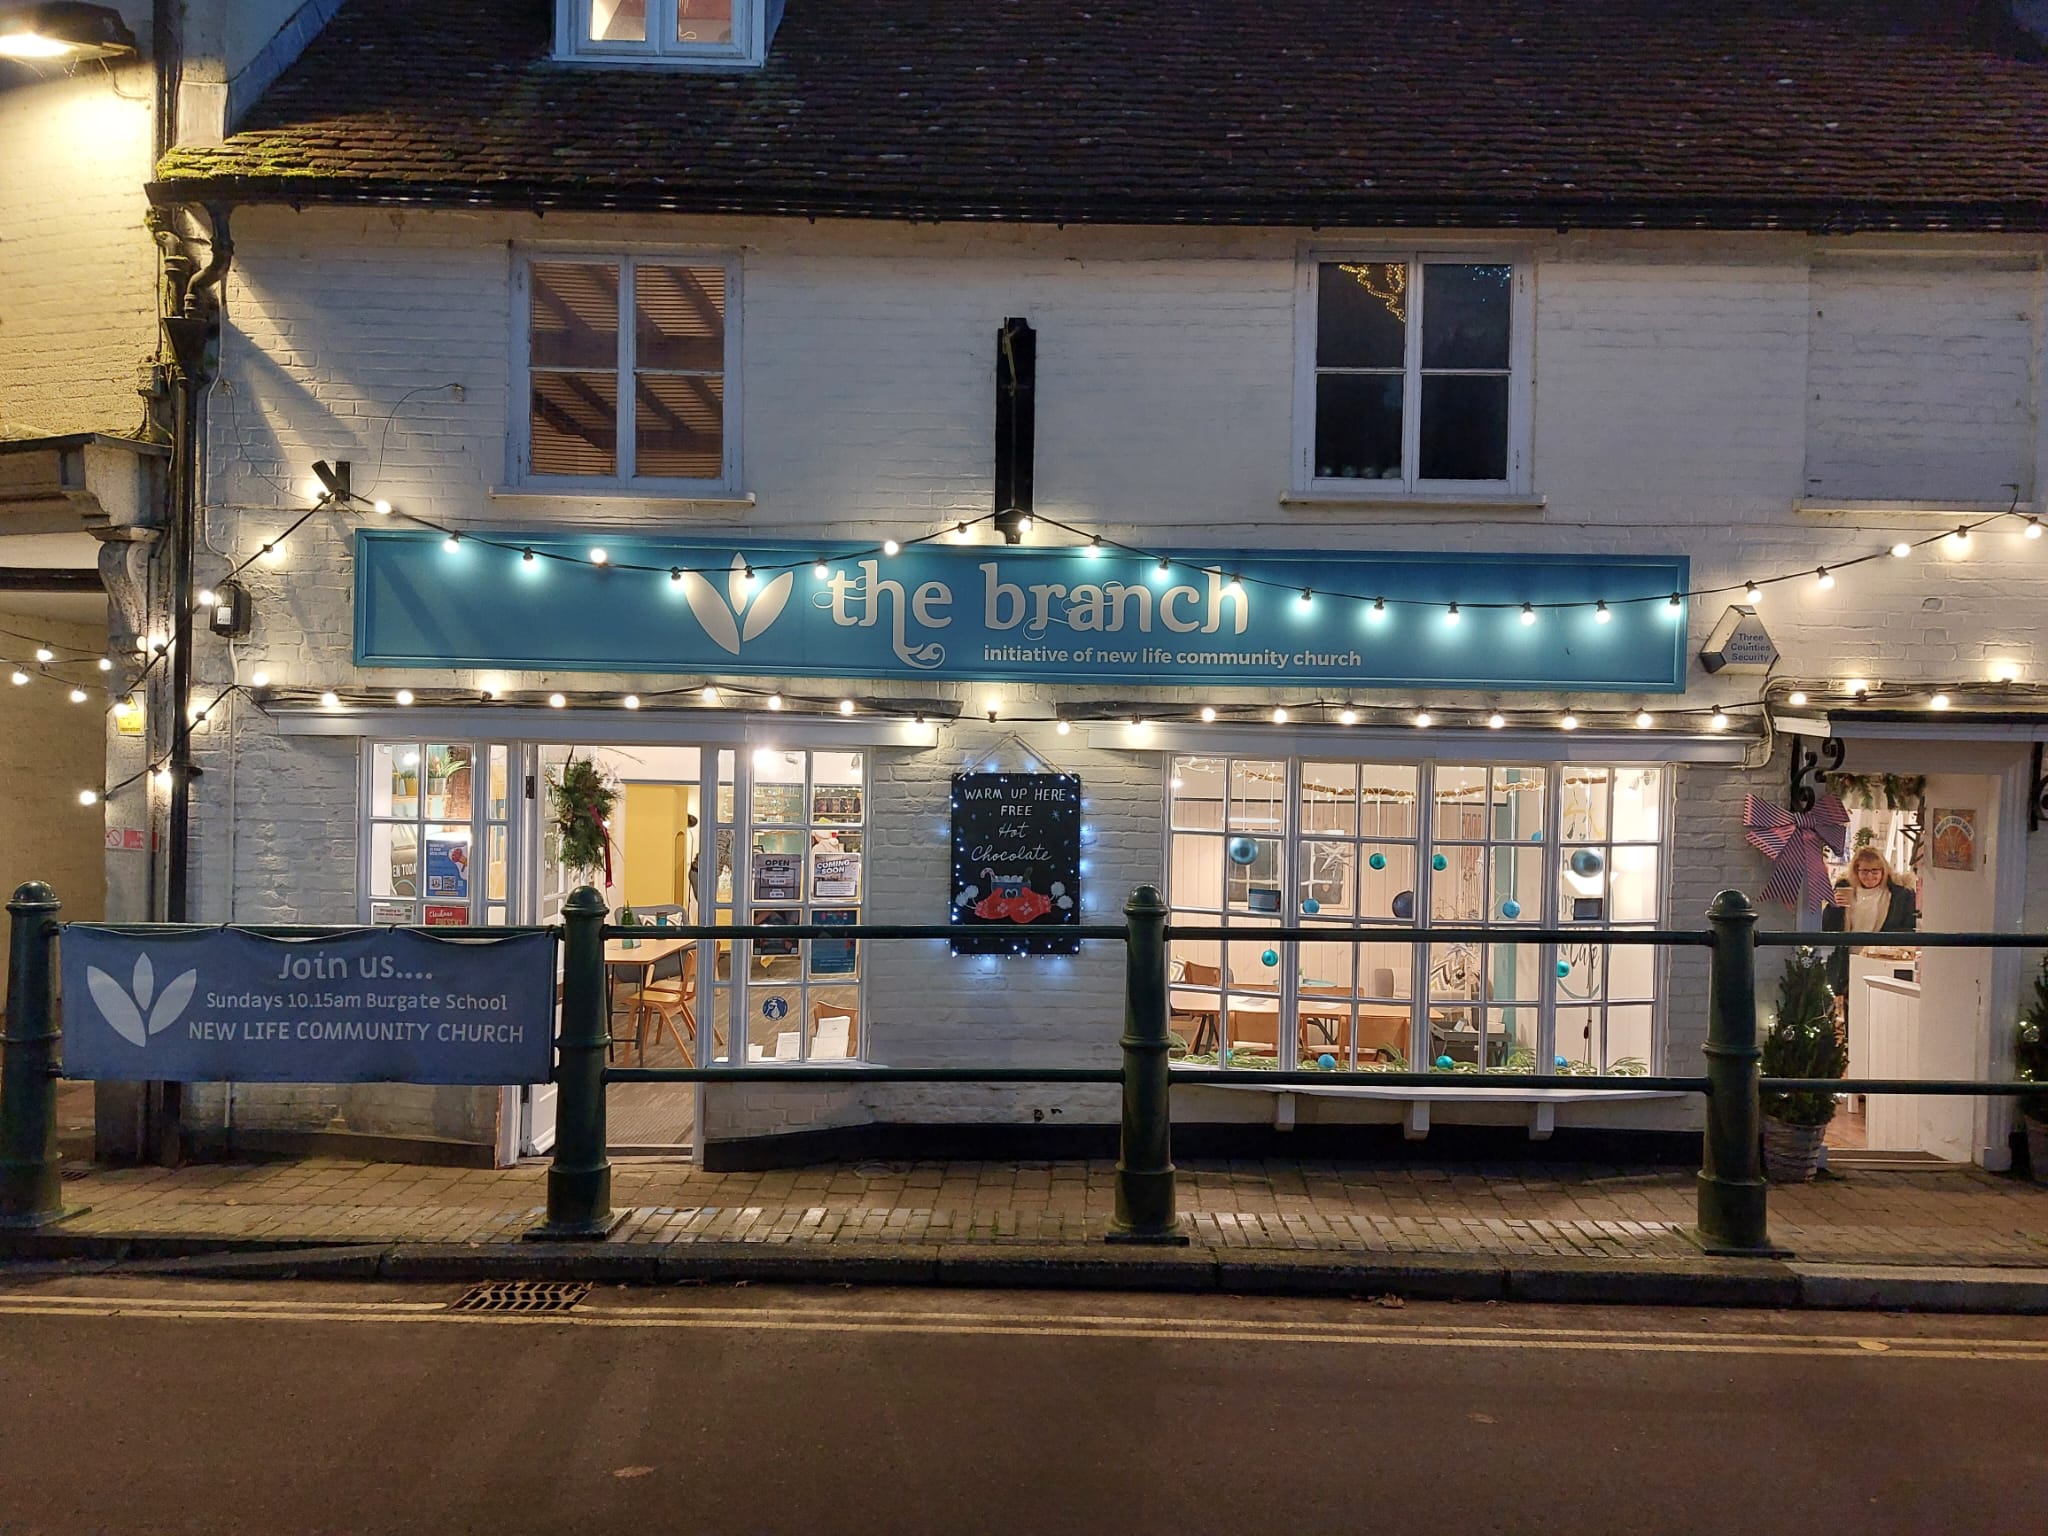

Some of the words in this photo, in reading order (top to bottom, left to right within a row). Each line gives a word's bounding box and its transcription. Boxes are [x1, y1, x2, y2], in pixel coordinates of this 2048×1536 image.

[812, 559, 953, 670] the
[979, 562, 1249, 641] branch
[1737, 632, 1764, 641] Three
[1730, 642, 1771, 651] Counties
[984, 644, 1068, 663] initiative
[1073, 648, 1094, 664] of
[1097, 650, 1137, 664] new
[1142, 648, 1172, 664] life
[1176, 649, 1288, 670] community
[1293, 650, 1362, 667] church
[1731, 653, 1769, 662] Security
[963, 788, 1003, 801] WARM
[1011, 788, 1028, 800] UP
[1034, 788, 1067, 802] HERE
[1000, 805, 1033, 816] FREE
[998, 822, 1030, 839] Hot
[971, 844, 1053, 862] Chocolate
[765, 859, 790, 867] OPEN
[816, 859, 850, 870] COMING
[821, 866, 846, 875] SOON
[278, 951, 348, 980] Join
[359, 956, 433, 980] us....
[206, 992, 283, 1011] Sundays
[288, 993, 361, 1009] 10.15am
[366, 993, 441, 1012] Burgate
[446, 994, 508, 1011] School
[188, 1022, 236, 1040] NEW
[243, 1022, 290, 1040] LIFE
[296, 1022, 431, 1041] COMMUNITY
[438, 1024, 524, 1044] CHURCH
